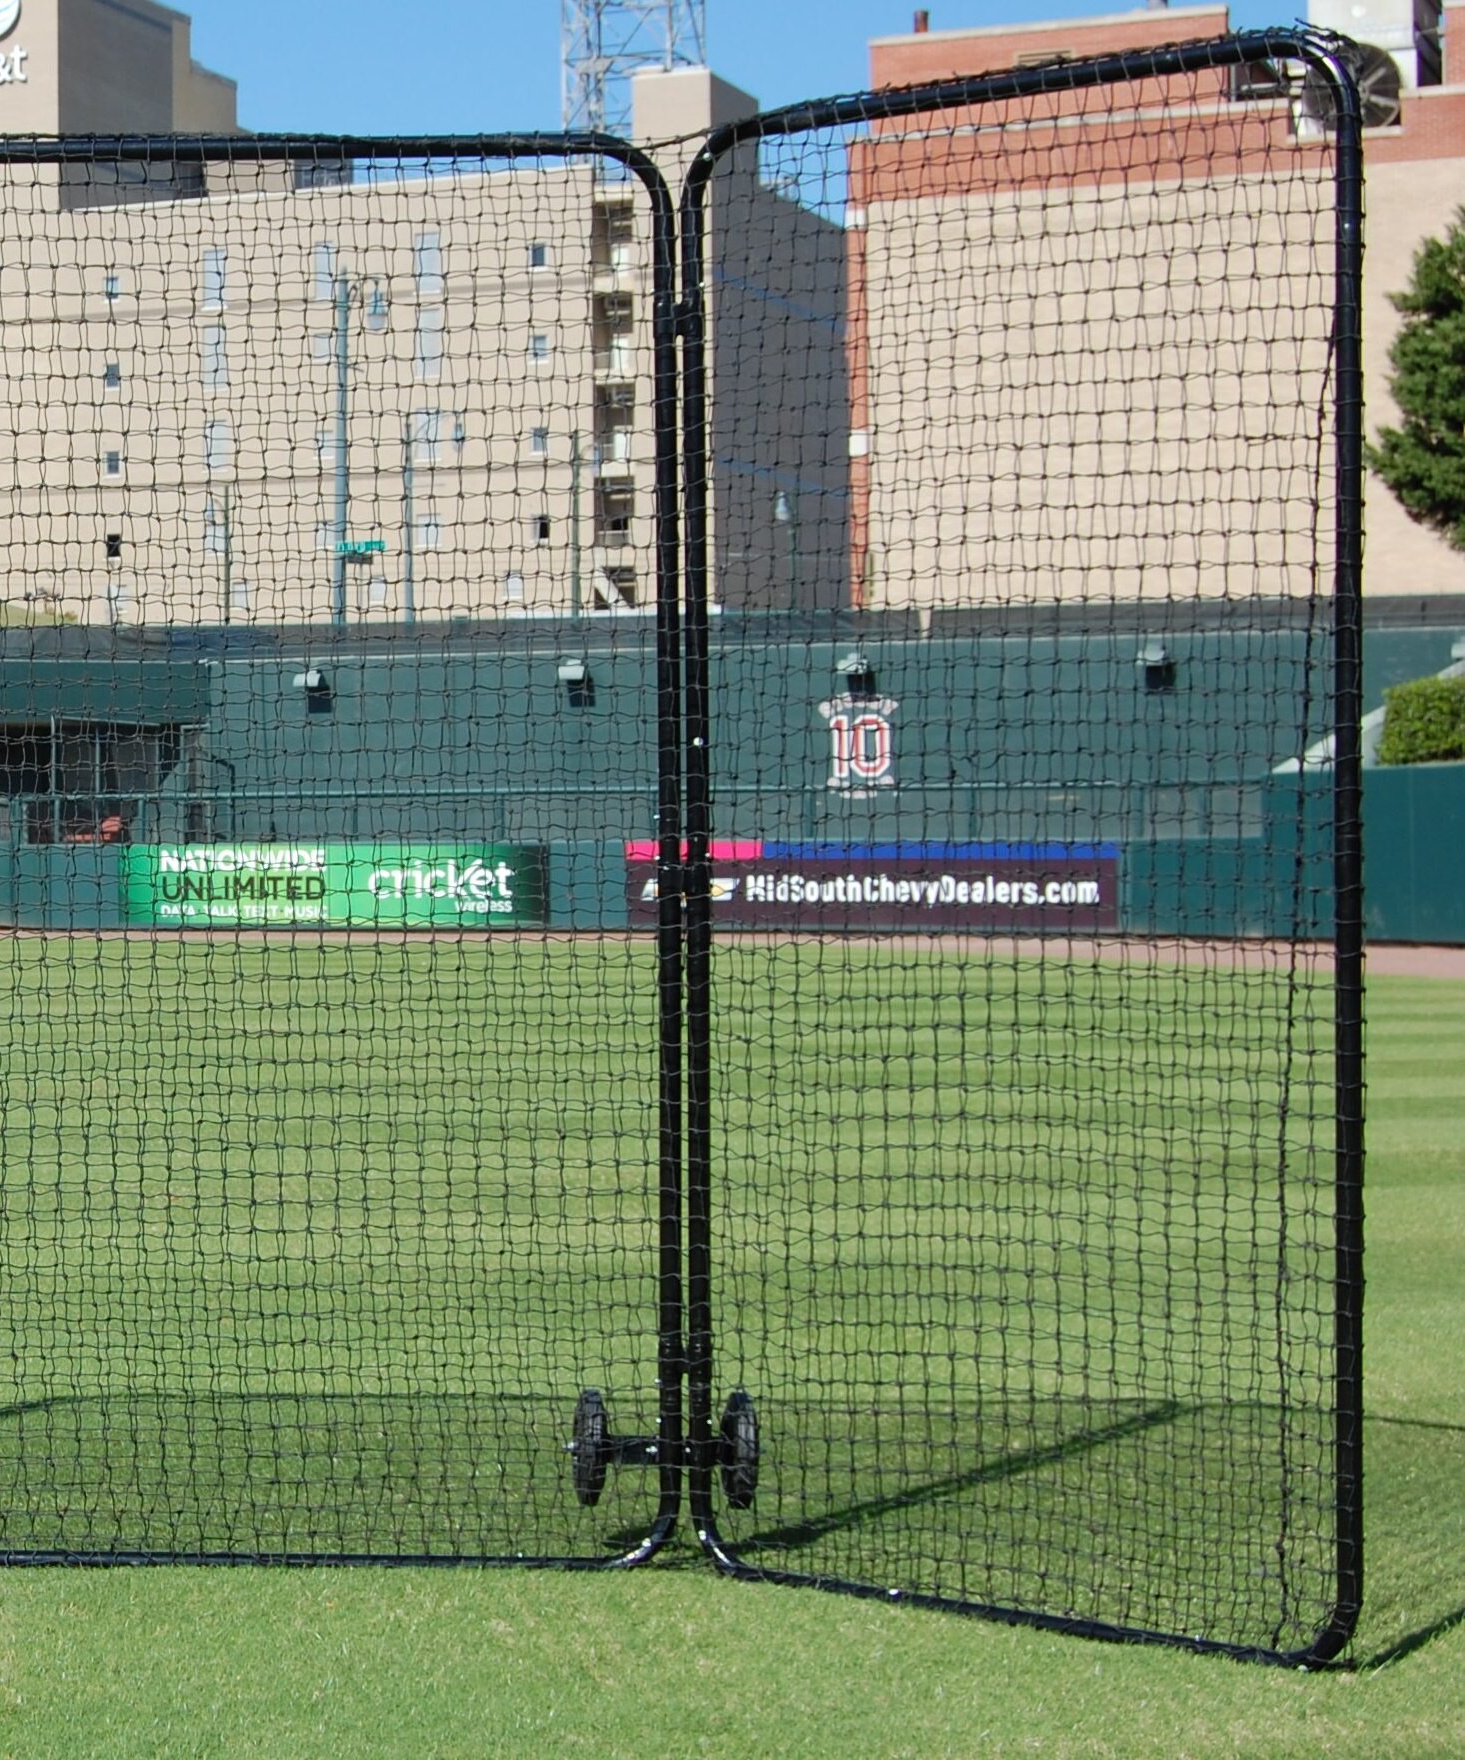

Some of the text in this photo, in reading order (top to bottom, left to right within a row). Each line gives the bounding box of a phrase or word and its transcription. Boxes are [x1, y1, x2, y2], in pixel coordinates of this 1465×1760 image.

[829, 714, 891, 777] 10
[160, 849, 327, 872] NATIONWIDE
[162, 876, 325, 900] UNLIMITED
[368, 858, 516, 899] cricket
[746, 873, 1100, 908] MidSouthChevyDealers.com
[160, 905, 196, 917] DATA
